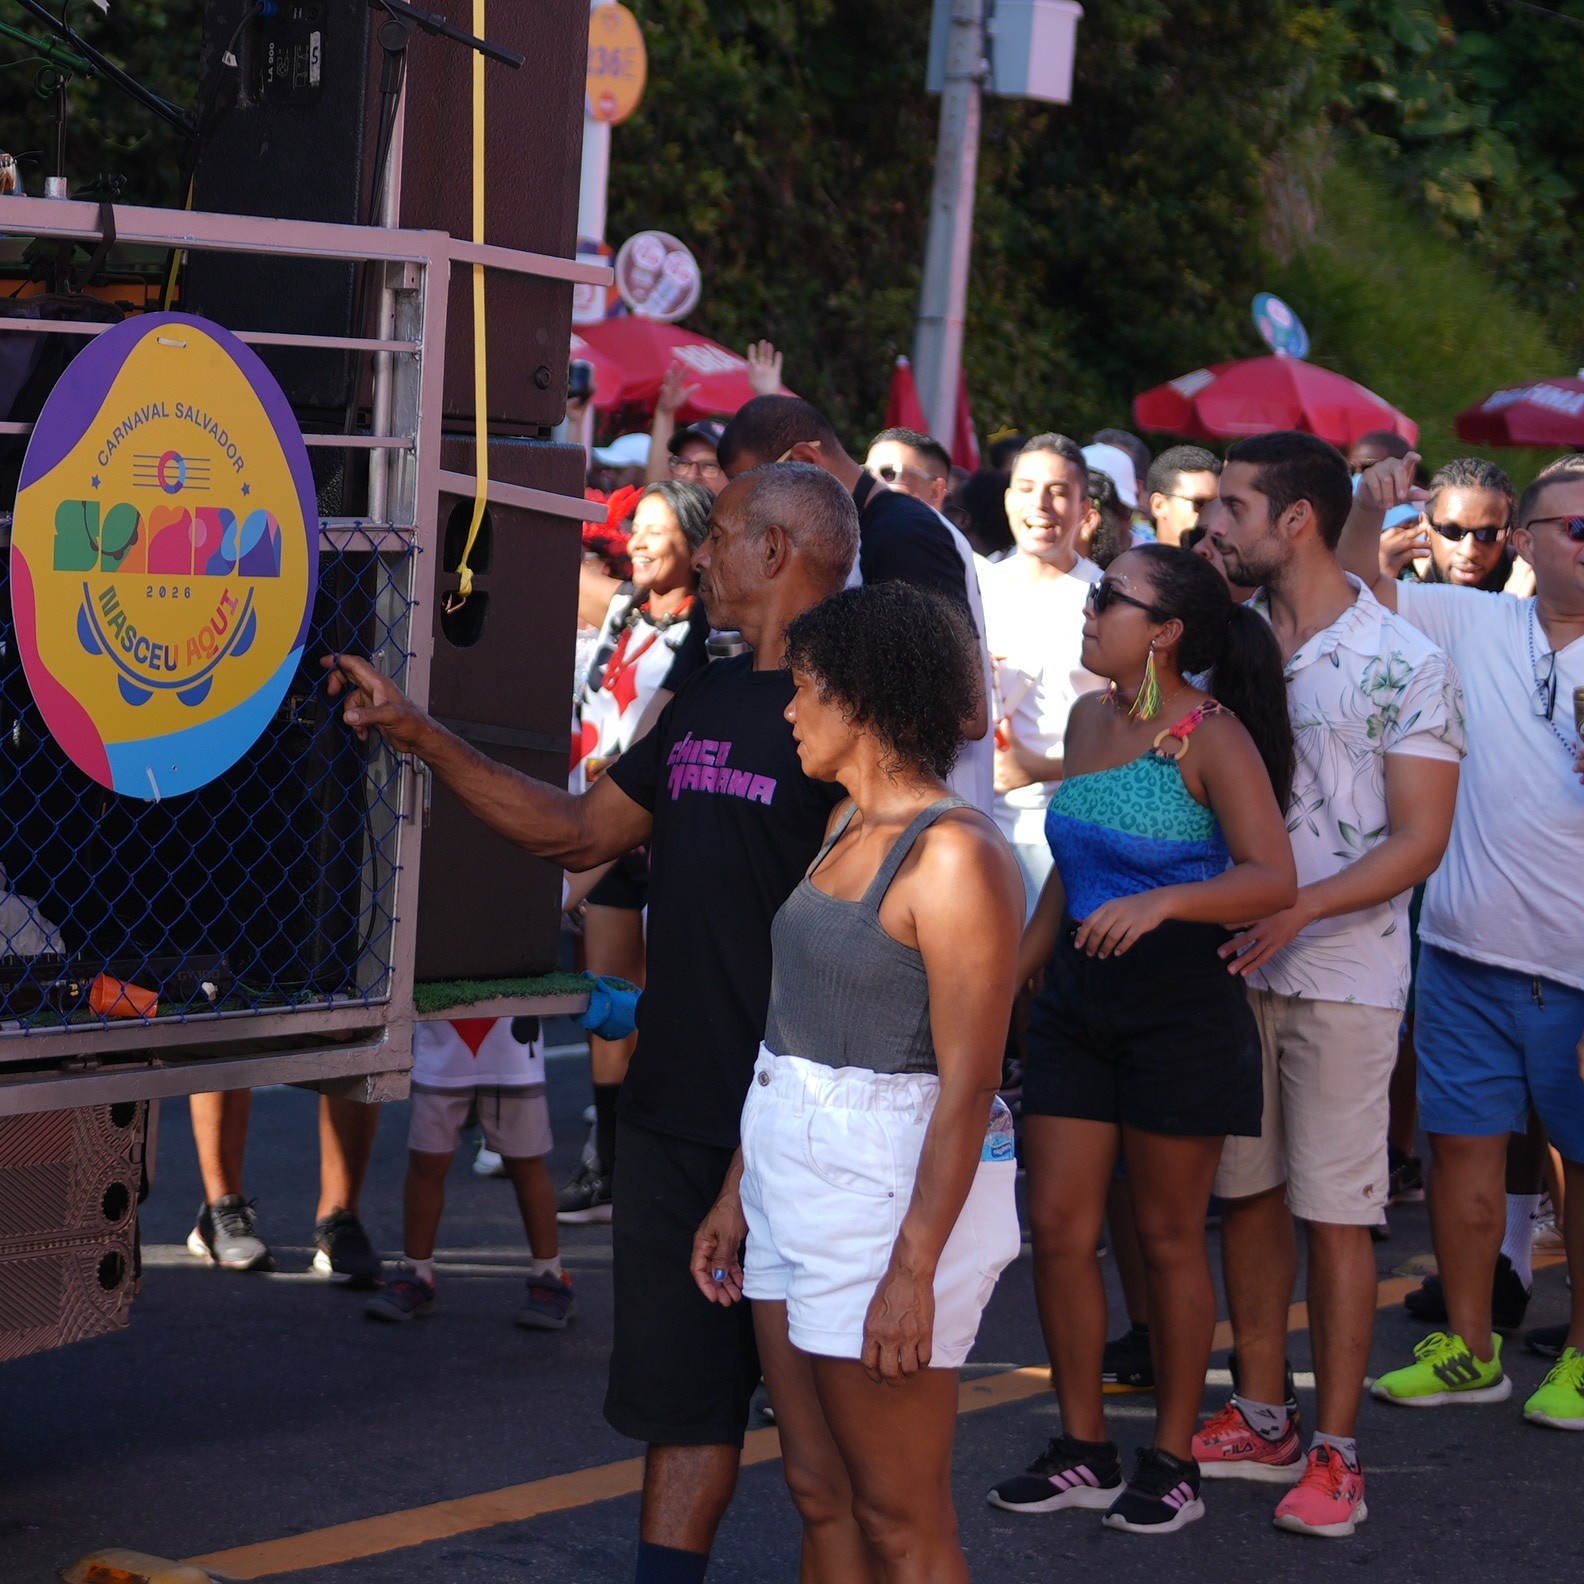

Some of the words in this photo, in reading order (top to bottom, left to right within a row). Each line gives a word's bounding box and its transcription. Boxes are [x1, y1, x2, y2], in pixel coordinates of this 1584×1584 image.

[97, 401, 170, 469] CARNAVAL
[174, 401, 245, 475] SALVADOR
[53, 499, 283, 578] SAMBA
[146, 585, 191, 599] 2026
[98, 584, 179, 673] NASCEU
[185, 587, 239, 667] AQUI
[666, 730, 732, 768] CHICO
[666, 763, 778, 806] MARANA
[1223, 1441, 1255, 1457] FILA
